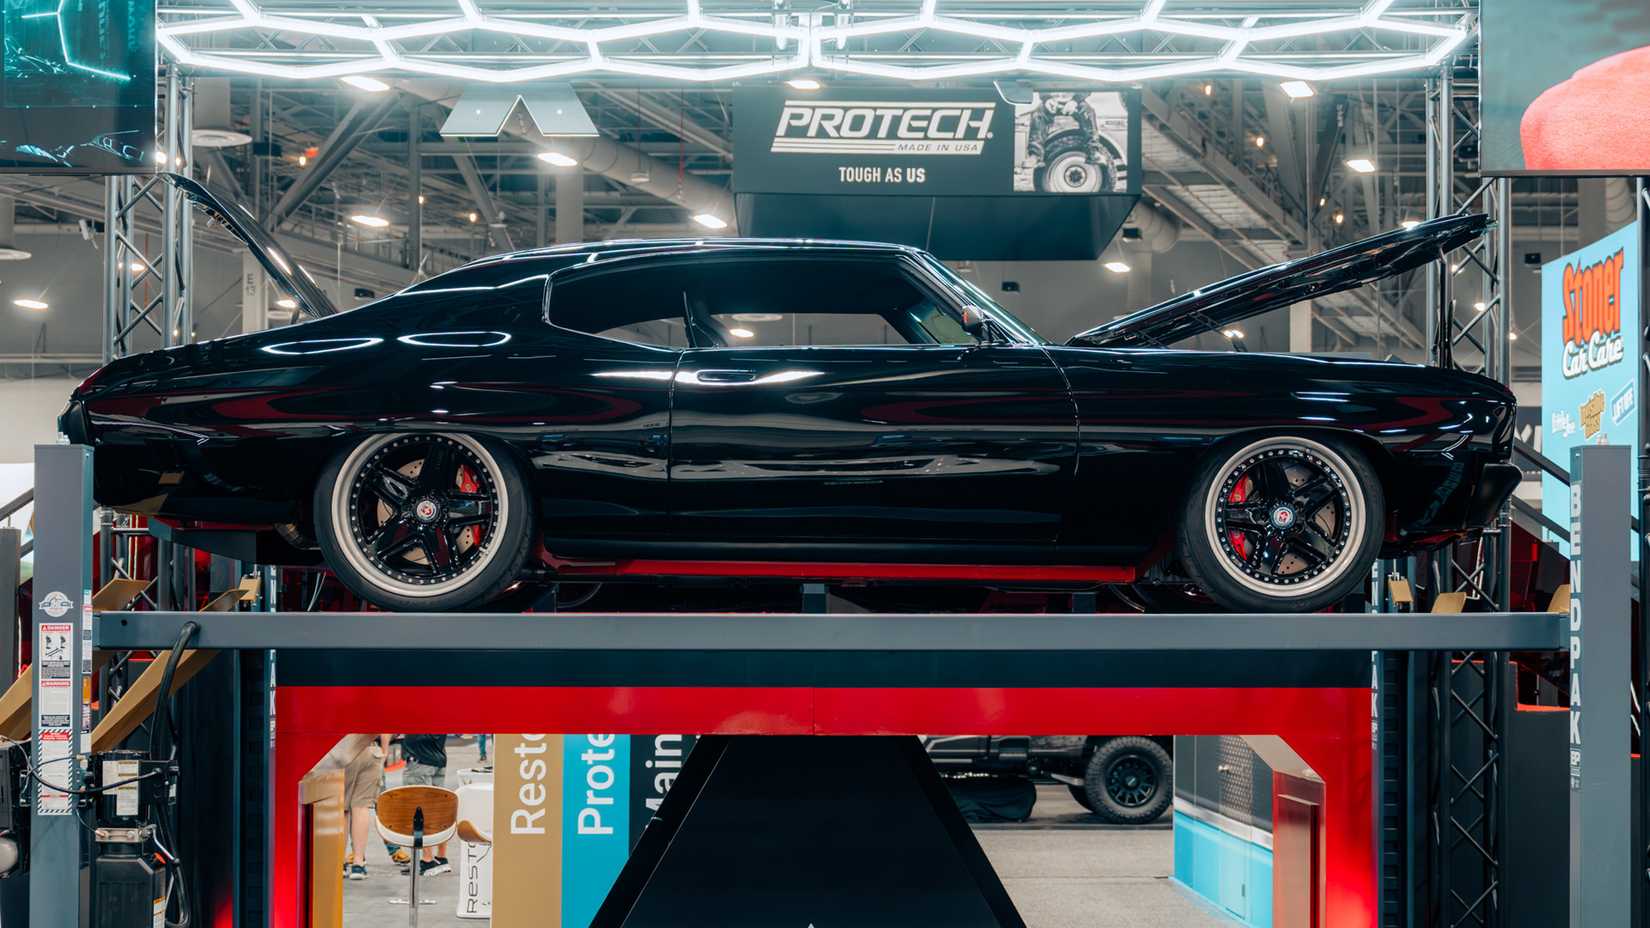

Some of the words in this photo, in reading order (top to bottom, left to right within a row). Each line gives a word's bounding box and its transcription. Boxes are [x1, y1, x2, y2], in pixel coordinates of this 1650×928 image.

[775, 108, 994, 139] PROTECH
[898, 143, 933, 152] MADE
[936, 143, 951, 152] IN
[955, 143, 979, 153] USA
[838, 166, 881, 183] TOUGH
[885, 167, 902, 183] AS
[906, 167, 926, 183] US
[1562, 247, 1624, 345] Stoner
[1562, 340, 1589, 378] Car
[1587, 330, 1625, 370] Care
[1570, 482, 1582, 745] BENDPAK
[510, 734, 547, 835] Rest
